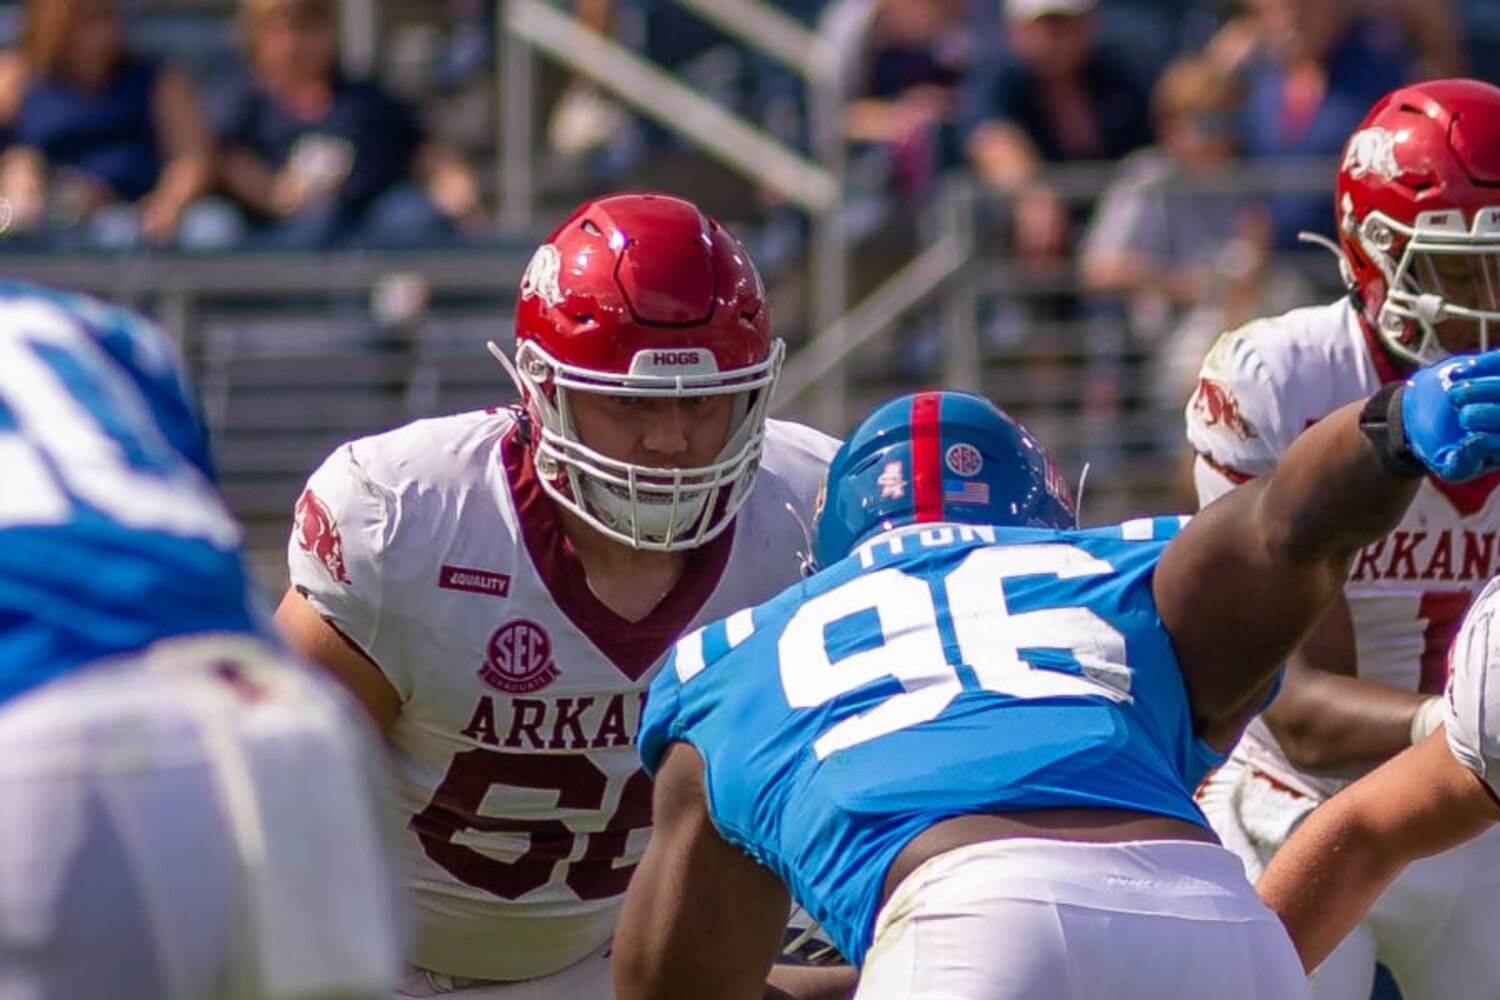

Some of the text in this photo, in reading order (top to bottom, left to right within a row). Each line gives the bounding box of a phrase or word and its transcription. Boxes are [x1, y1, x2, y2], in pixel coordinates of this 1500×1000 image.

[653, 352, 699, 365] HOGS
[494, 625, 544, 675] SEC
[778, 543, 1133, 760] 96
[460, 691, 648, 750] ARKA
